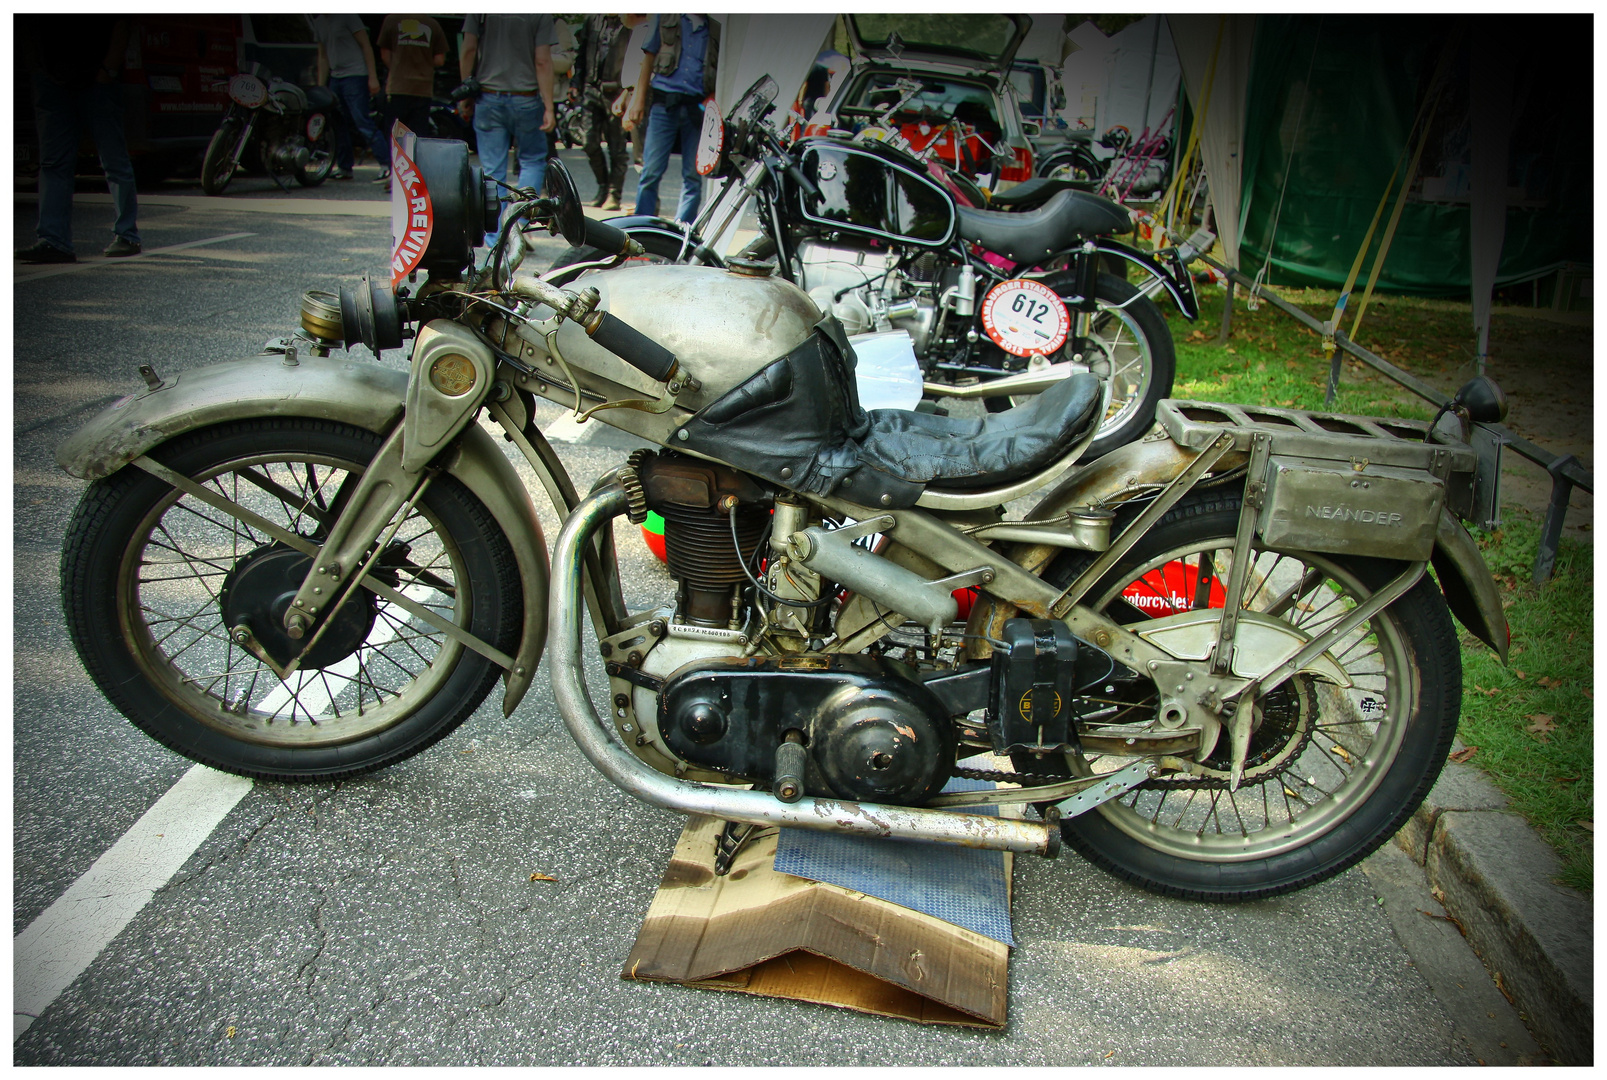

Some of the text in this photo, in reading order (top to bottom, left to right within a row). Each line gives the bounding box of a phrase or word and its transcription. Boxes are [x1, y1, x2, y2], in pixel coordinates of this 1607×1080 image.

[240, 80, 256, 93] 769
[983, 281, 1021, 330] HAMBURGER
[1011, 293, 1049, 324] 612
